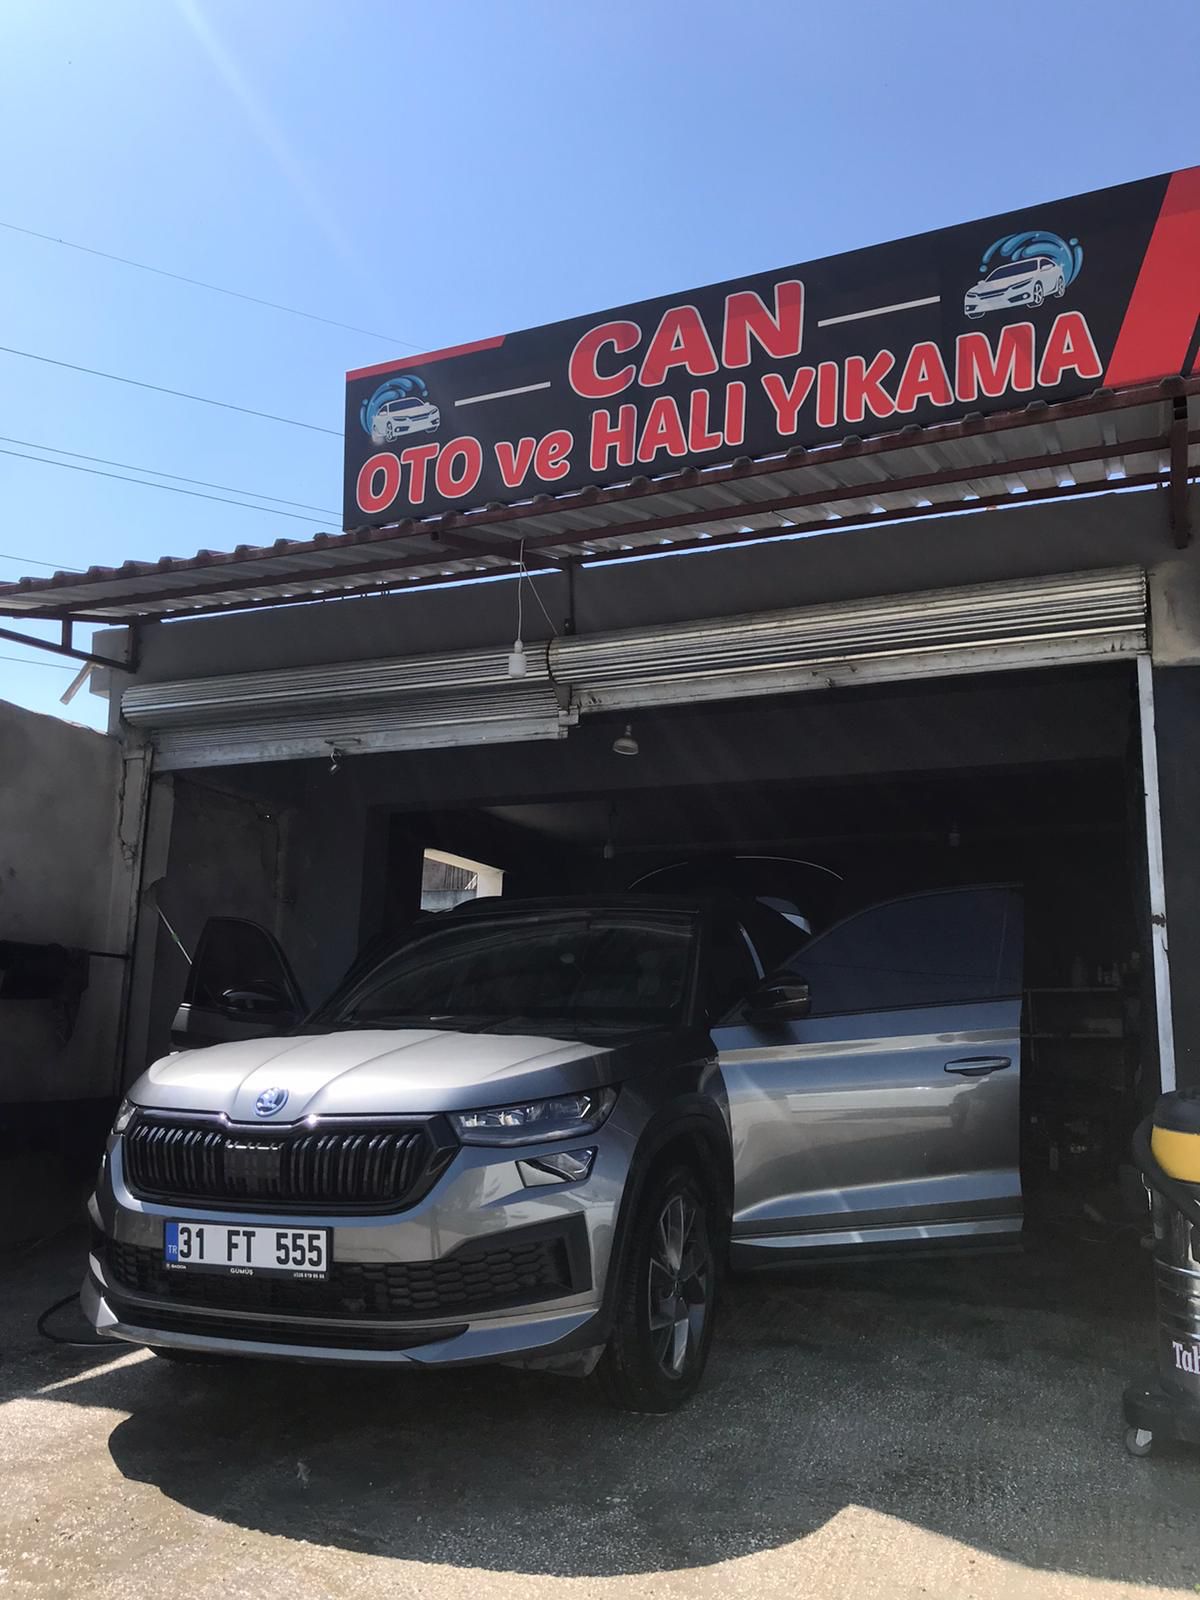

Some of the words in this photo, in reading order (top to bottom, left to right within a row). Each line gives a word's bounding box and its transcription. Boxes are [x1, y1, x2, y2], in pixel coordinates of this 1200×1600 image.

[568, 280, 805, 399] CAN
[356, 435, 482, 515] OTO
[496, 430, 573, 488] ve
[590, 382, 746, 472] HALI
[762, 310, 1104, 436] YIKAMA
[168, 1244, 178, 1255] TR
[179, 1227, 205, 1260] 31
[227, 1229, 256, 1263] FT
[276, 1232, 323, 1267] 555
